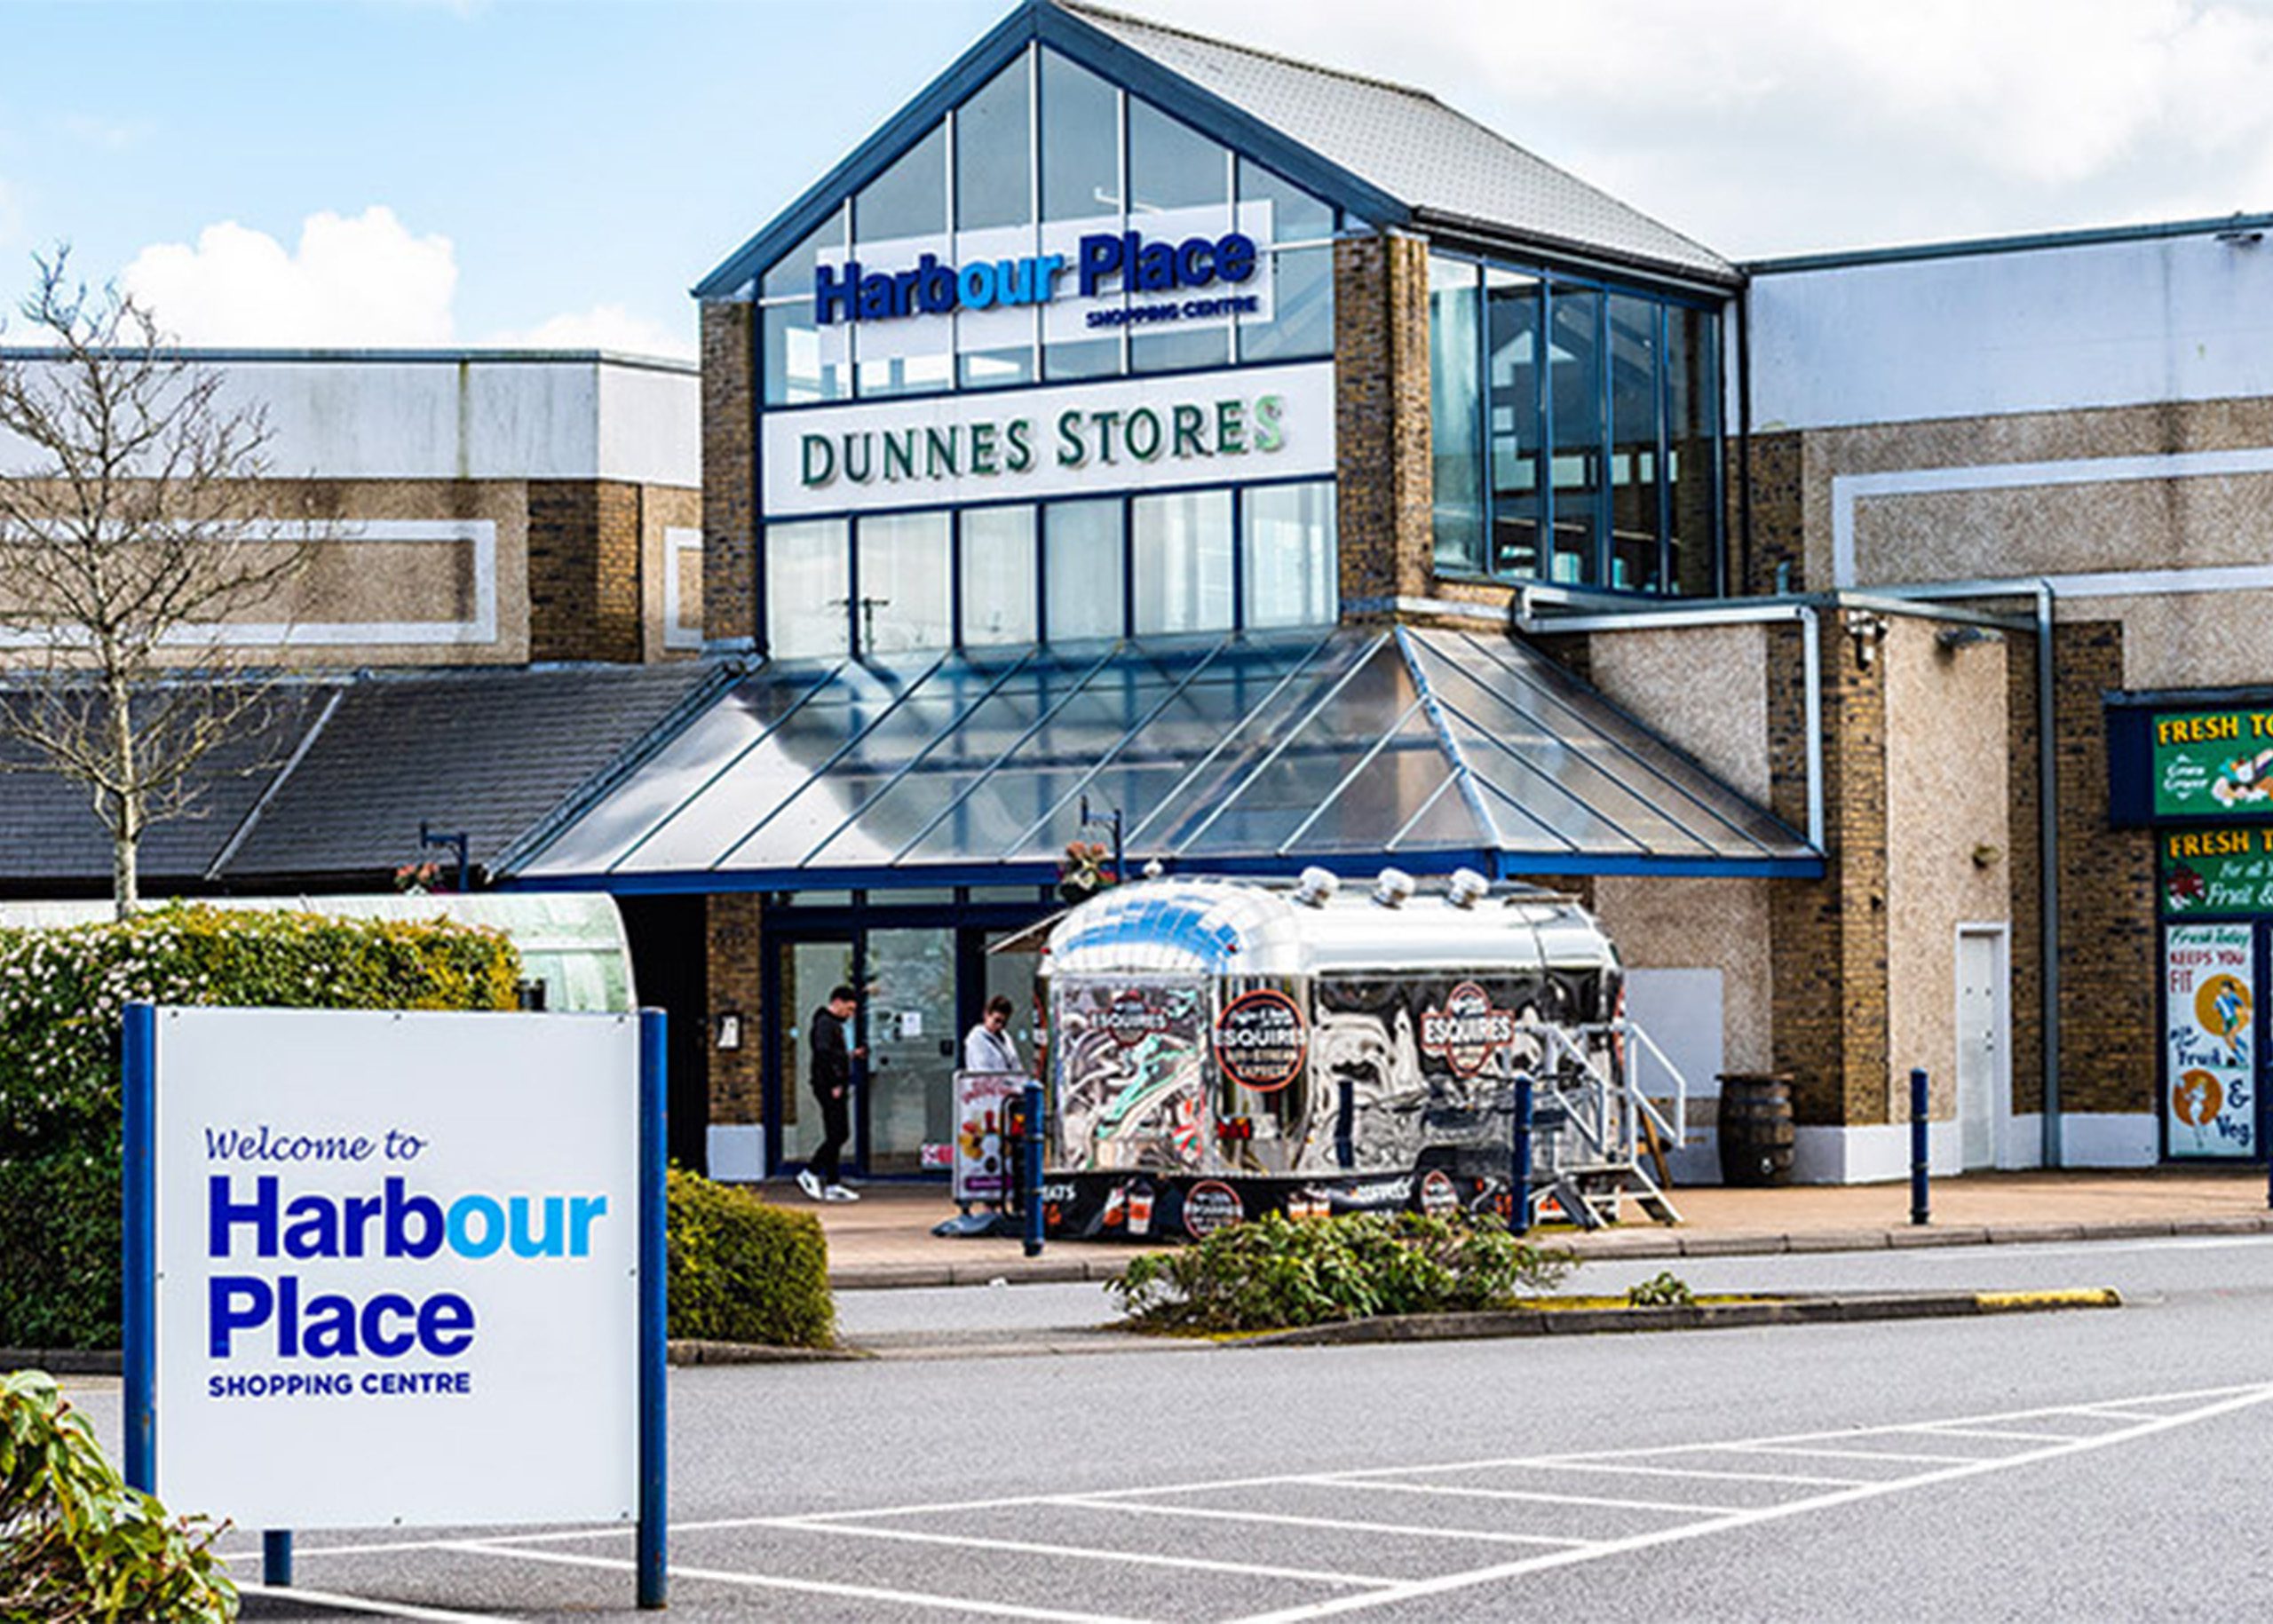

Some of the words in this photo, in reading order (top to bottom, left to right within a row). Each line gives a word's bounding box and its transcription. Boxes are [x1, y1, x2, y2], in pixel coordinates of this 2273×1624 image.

[815, 253, 1065, 325] Harbour
[1078, 231, 1257, 297] Place
[1085, 303, 1179, 329] SHOPPING
[1183, 294, 1259, 319] CENTRE
[800, 420, 1033, 487] DUNNES
[1057, 395, 1284, 466] STORES
[2158, 715, 2239, 746] FRESH
[2169, 830, 2250, 859] FRESH
[2217, 950, 2246, 965] YOU
[2170, 970, 2193, 994] FIT
[1423, 1017, 1510, 1043] ESQUIRES
[2228, 1079, 2251, 1109] &
[205, 1126, 376, 1161] Welcome
[384, 1128, 429, 1161] to
[2217, 1115, 2251, 1146] Veg
[208, 1175, 607, 1259] Harbour
[208, 1275, 475, 1359] Place
[208, 1374, 354, 1398] SHOPPING
[360, 1373, 471, 1394] CENTRE
